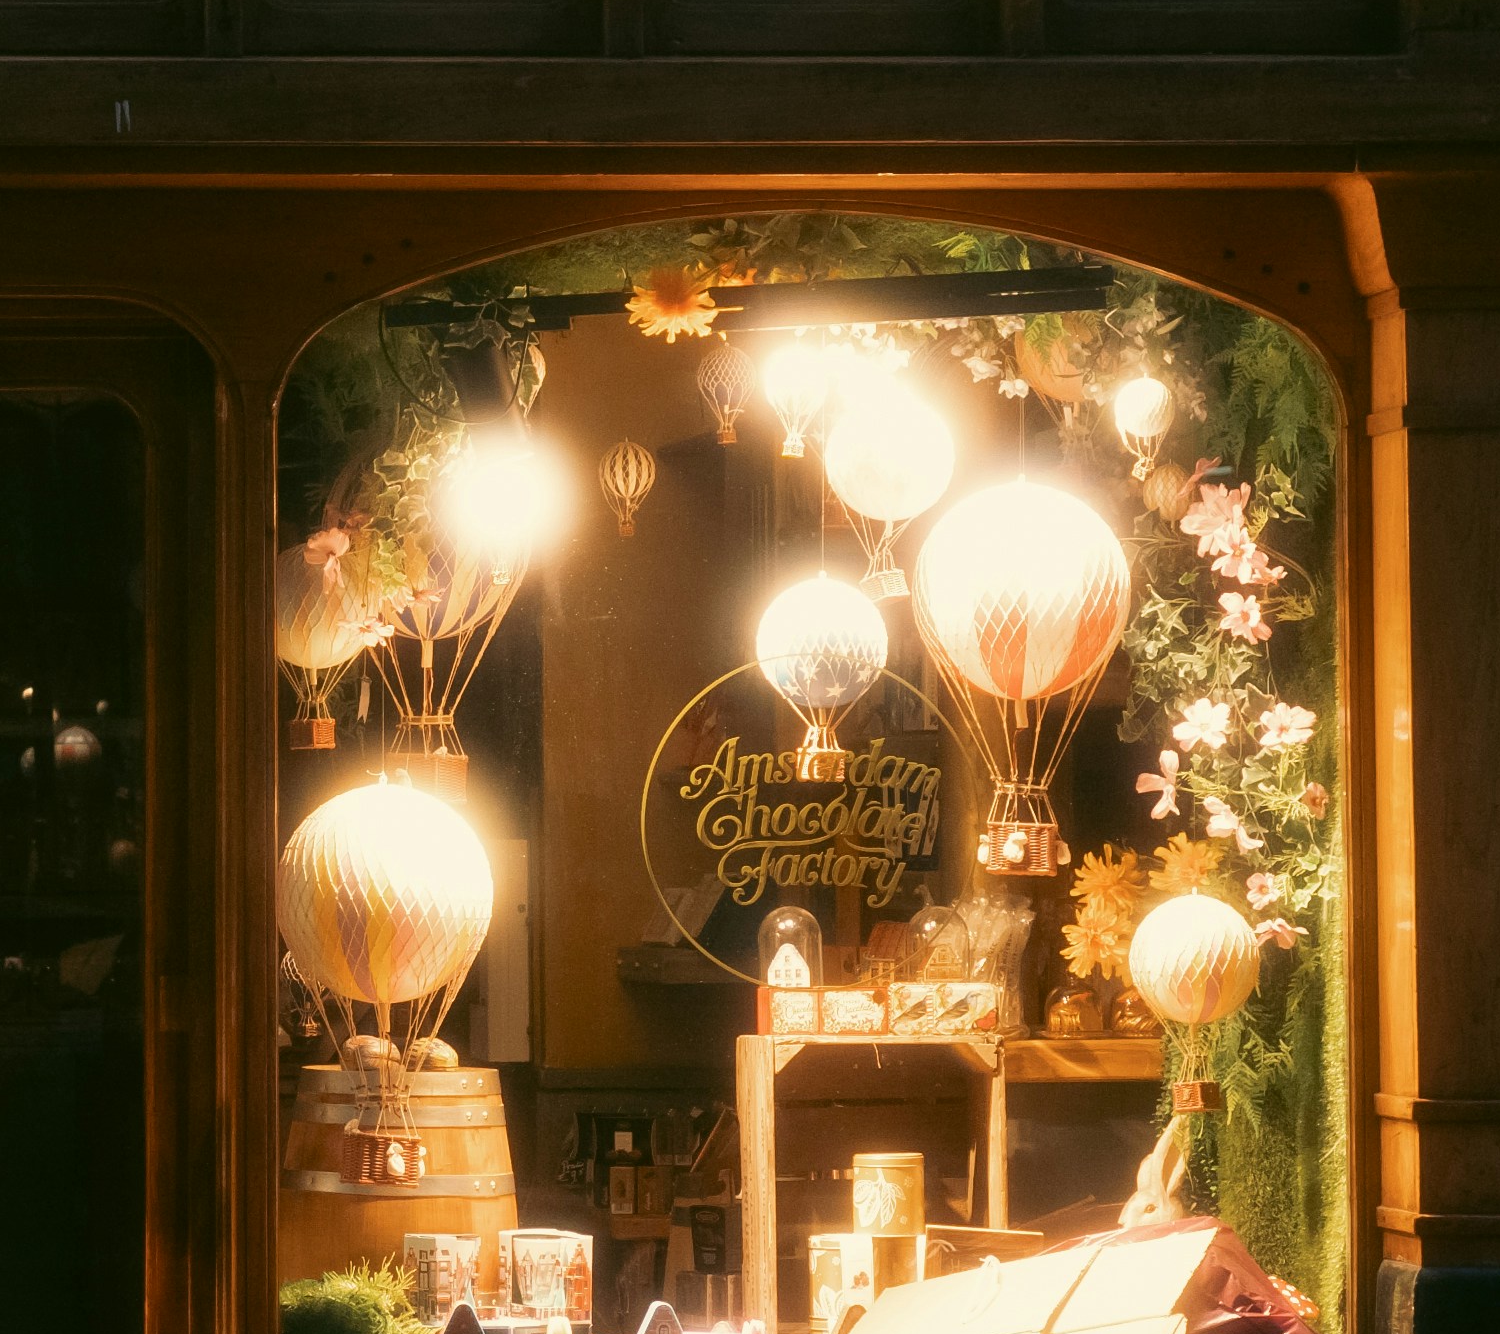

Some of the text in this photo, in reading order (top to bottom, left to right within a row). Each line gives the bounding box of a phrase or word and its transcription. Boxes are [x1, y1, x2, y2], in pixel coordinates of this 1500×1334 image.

[680, 736, 942, 801] Amsterdam
[697, 784, 926, 851] Chocolate
[717, 839, 906, 909] Factory
